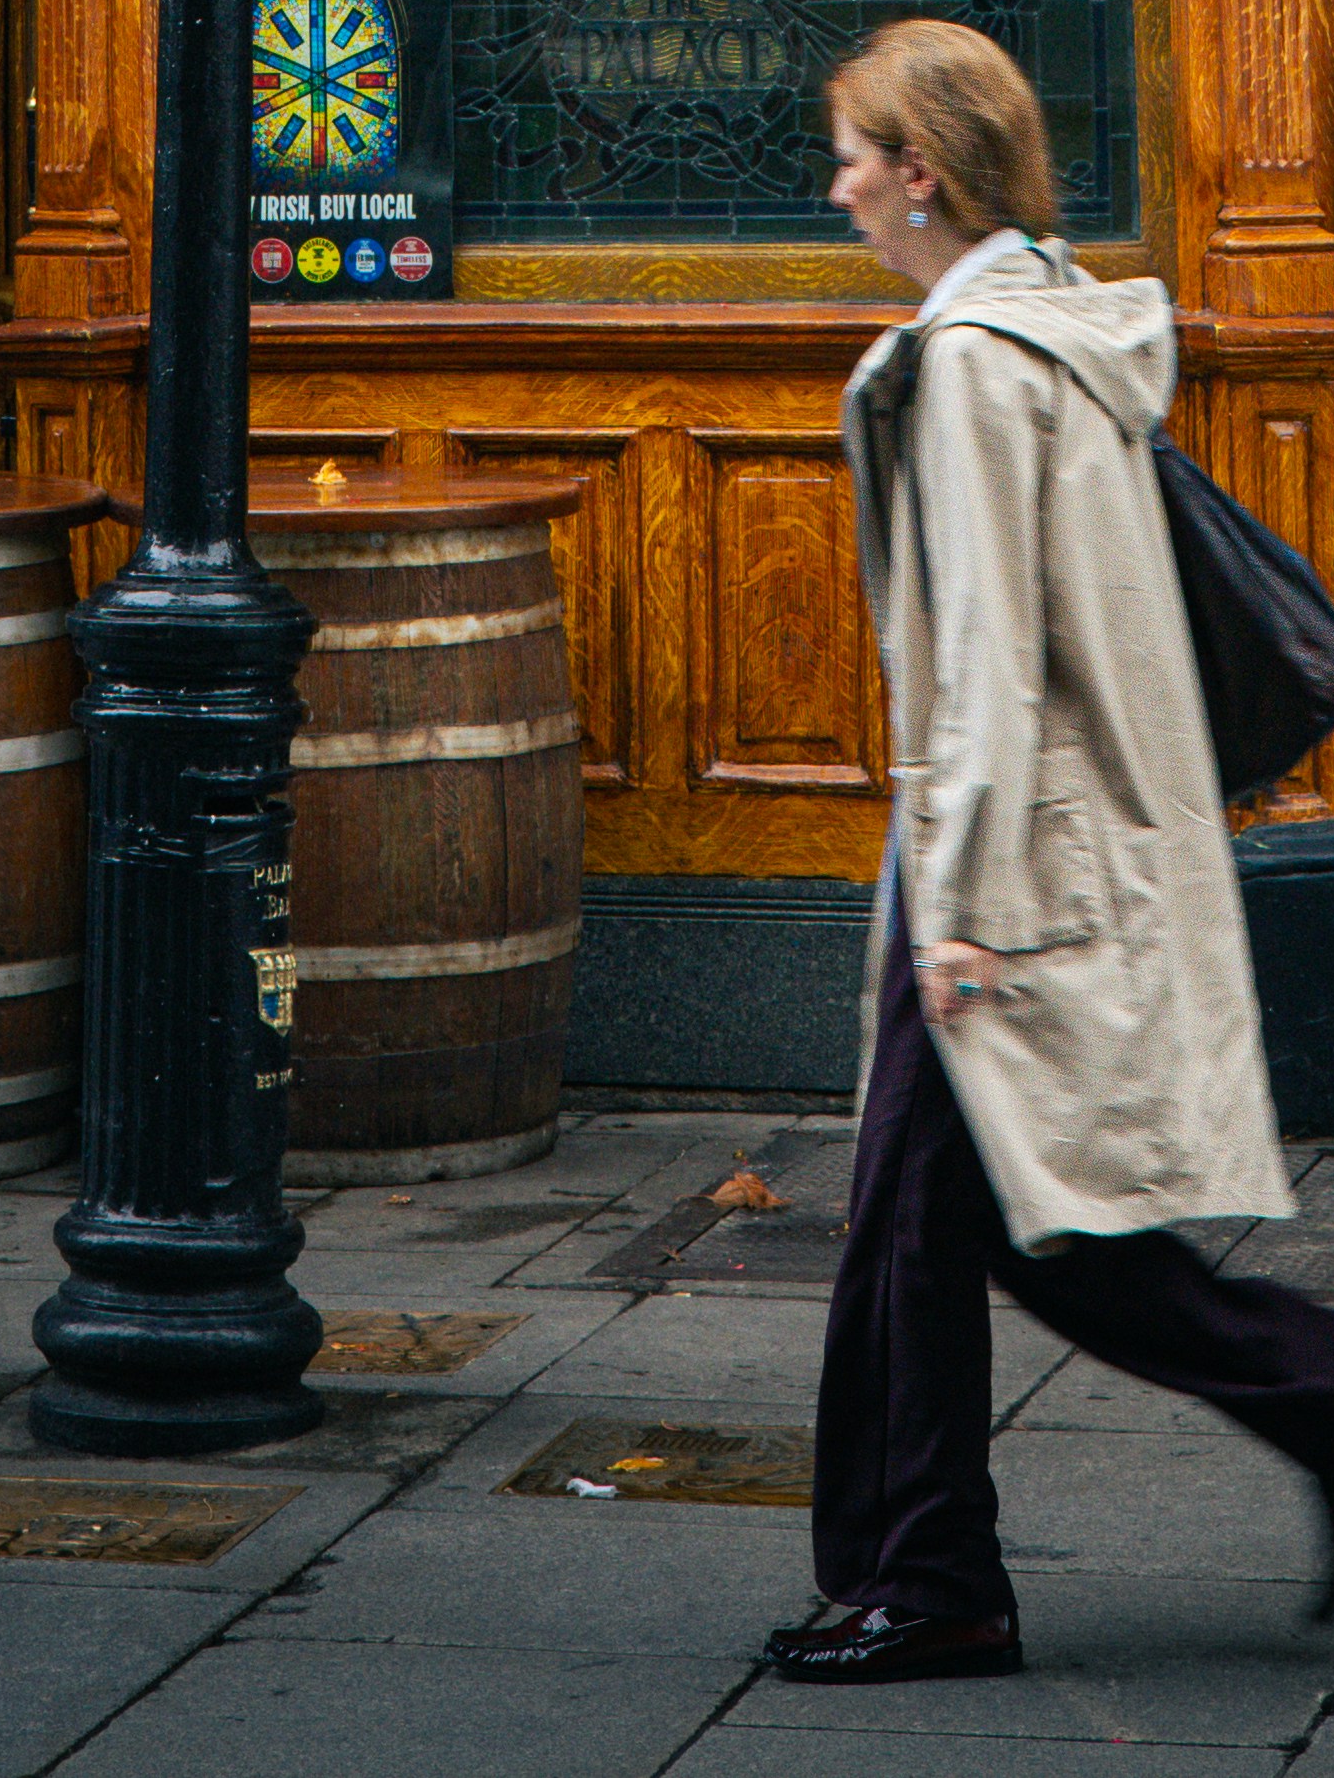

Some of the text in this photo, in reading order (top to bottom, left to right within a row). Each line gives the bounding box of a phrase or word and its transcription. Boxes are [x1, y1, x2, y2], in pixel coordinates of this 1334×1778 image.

[260, 194, 315, 225] IRISH,
[320, 194, 357, 221] BUY
[361, 193, 417, 220] LOCAL
